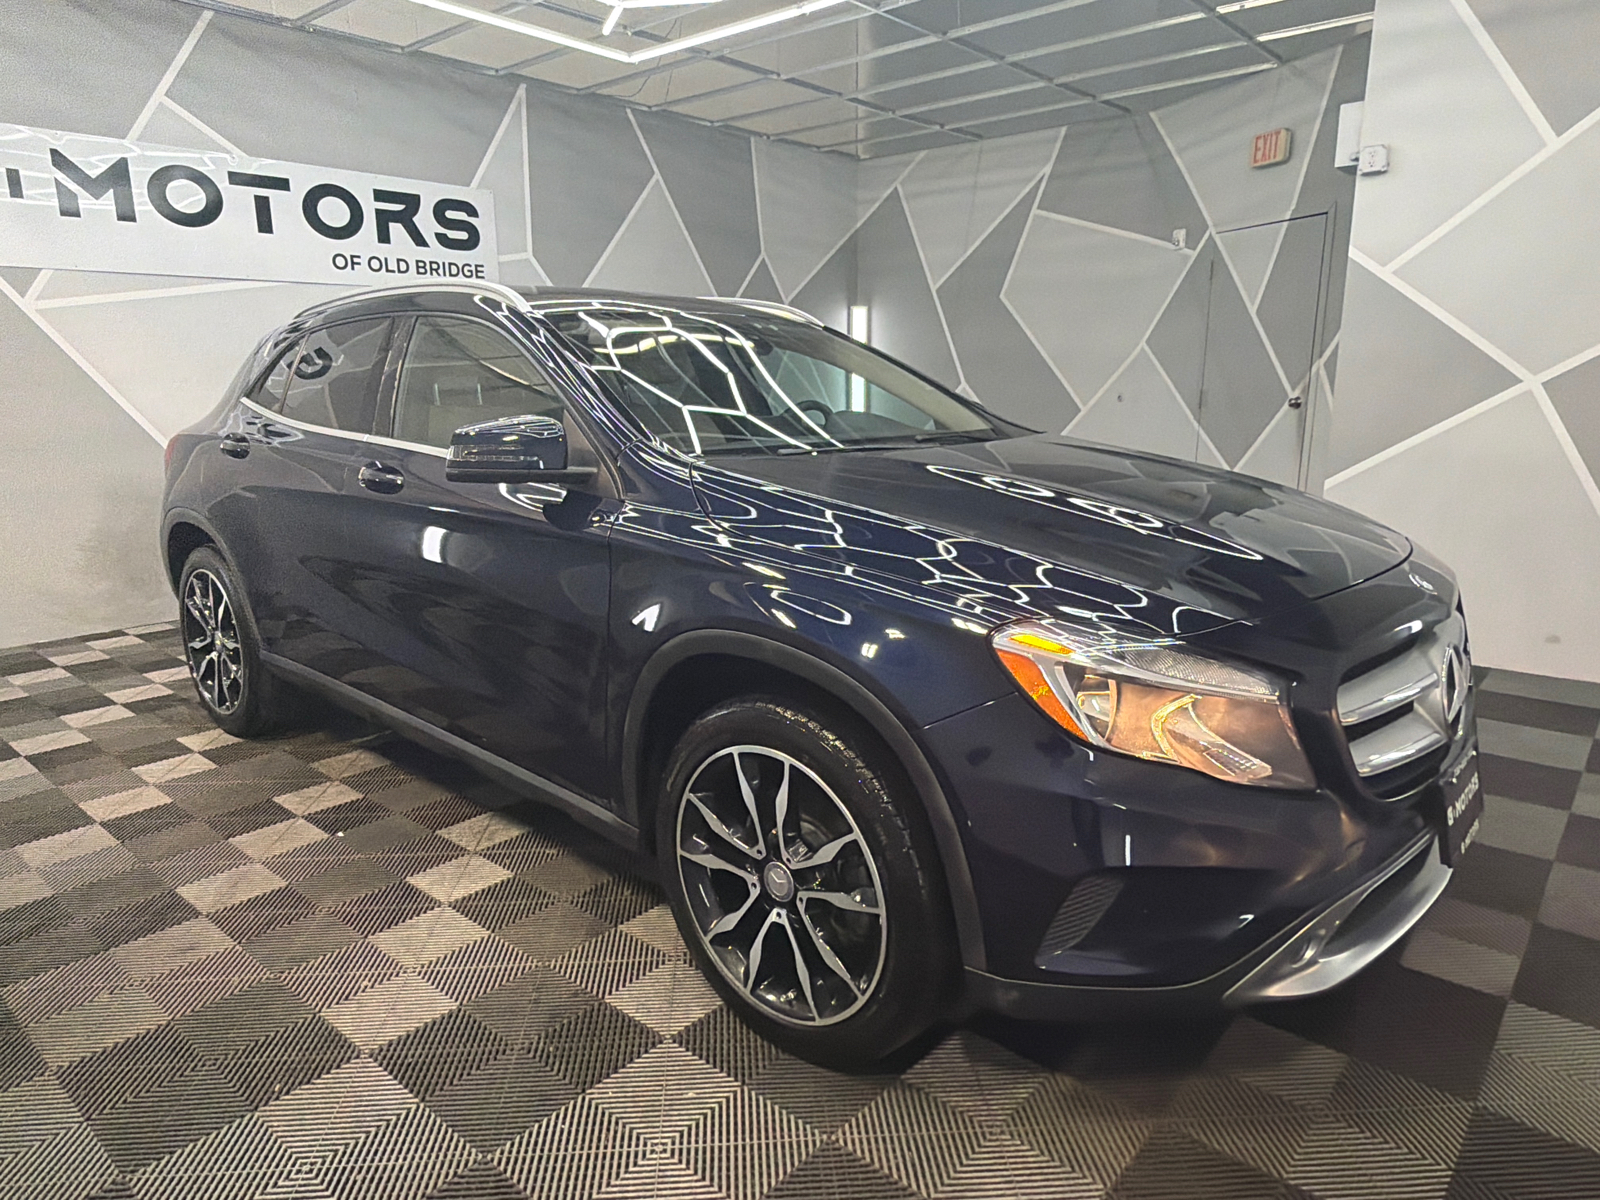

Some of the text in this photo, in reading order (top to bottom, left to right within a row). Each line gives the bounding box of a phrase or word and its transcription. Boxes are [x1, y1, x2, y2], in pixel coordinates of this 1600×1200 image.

[1253, 130, 1281, 165] EXIT
[49, 148, 481, 251] MOTORS
[332, 253, 485, 279] OF OLD BRIDGE
